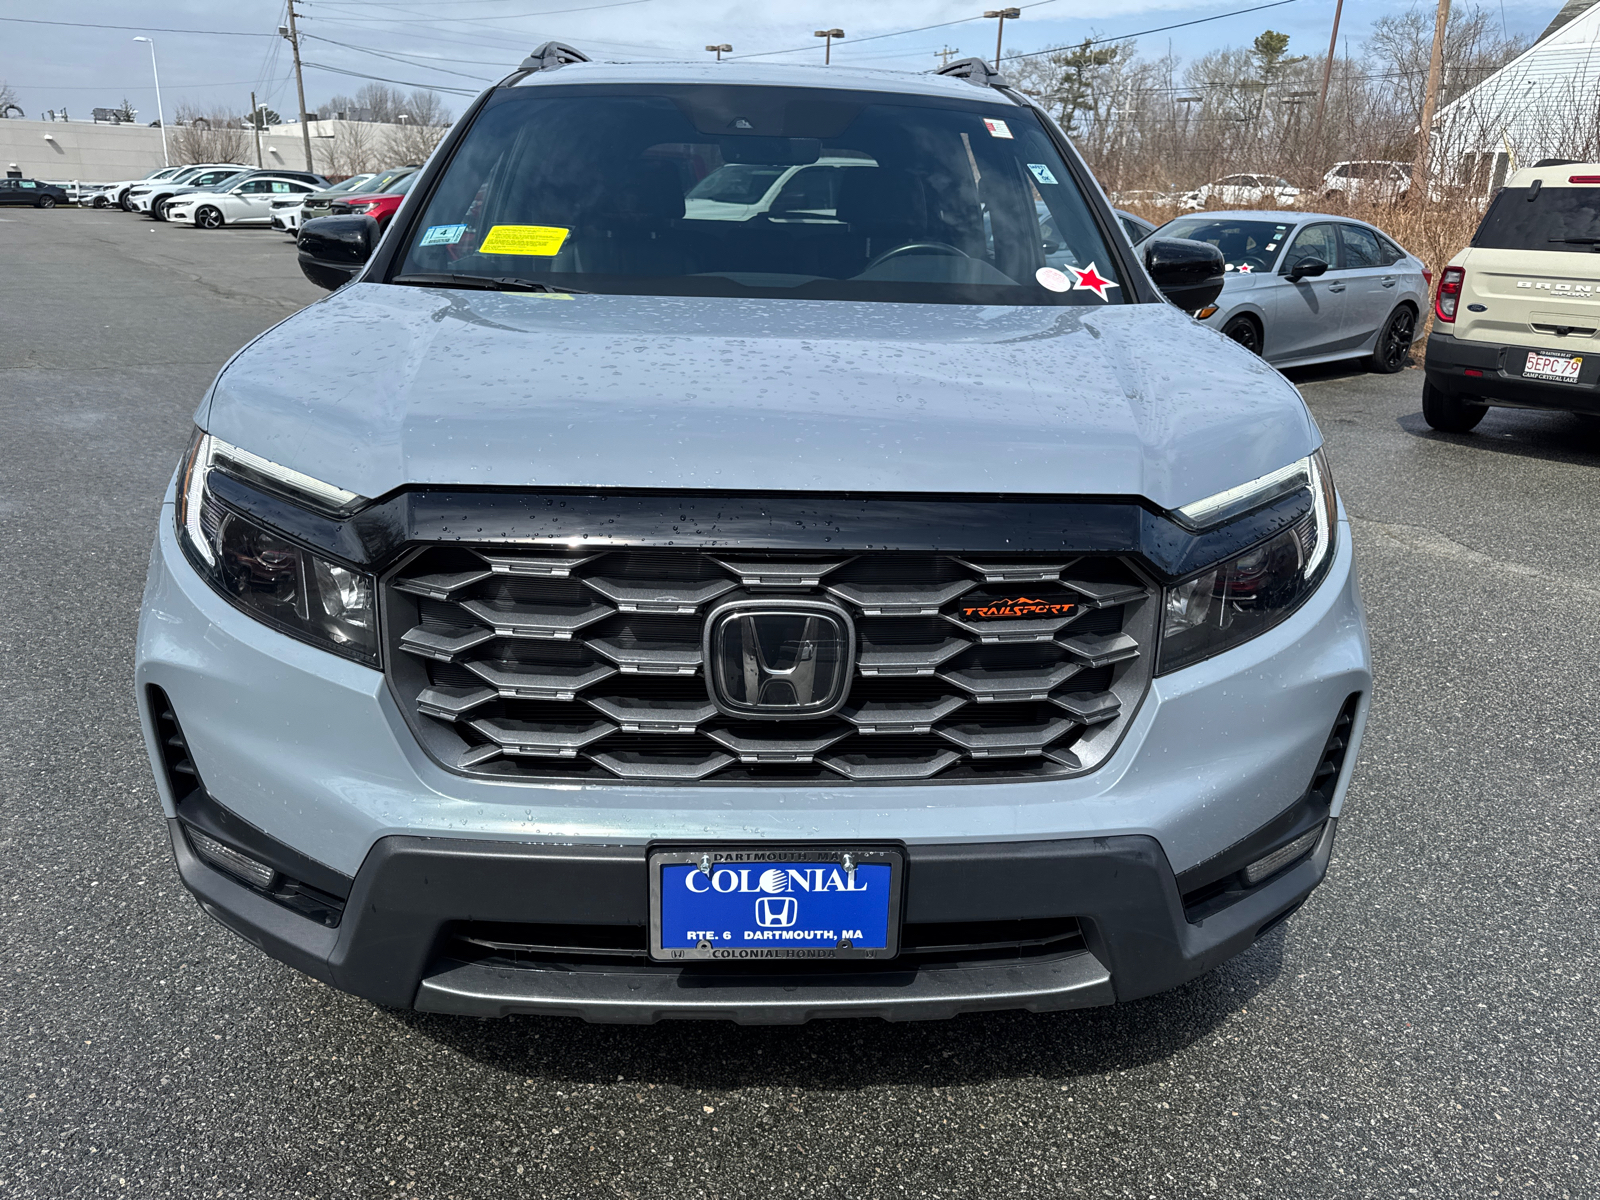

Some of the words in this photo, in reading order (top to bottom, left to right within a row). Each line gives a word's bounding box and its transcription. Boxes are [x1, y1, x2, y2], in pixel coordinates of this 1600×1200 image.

[1517, 281, 1600, 294] BRON
[1550, 290, 1593, 298] SPORT
[1526, 356, 1560, 373] 5EPC
[1561, 360, 1579, 375] 79
[1538, 373, 1563, 382] CRYSTAL
[1563, 376, 1578, 384] LAKE
[963, 604, 1075, 617] TRAILSPORT
[713, 852, 813, 862] DARTMOUTH,
[819, 852, 840, 861] MA
[686, 931, 719, 940] RTE.
[722, 931, 732, 940] 6
[743, 930, 838, 941] DARTMOUTH,
[841, 929, 864, 939] MA
[712, 949, 786, 959] COLONIAL
[786, 949, 837, 958] HONDA
